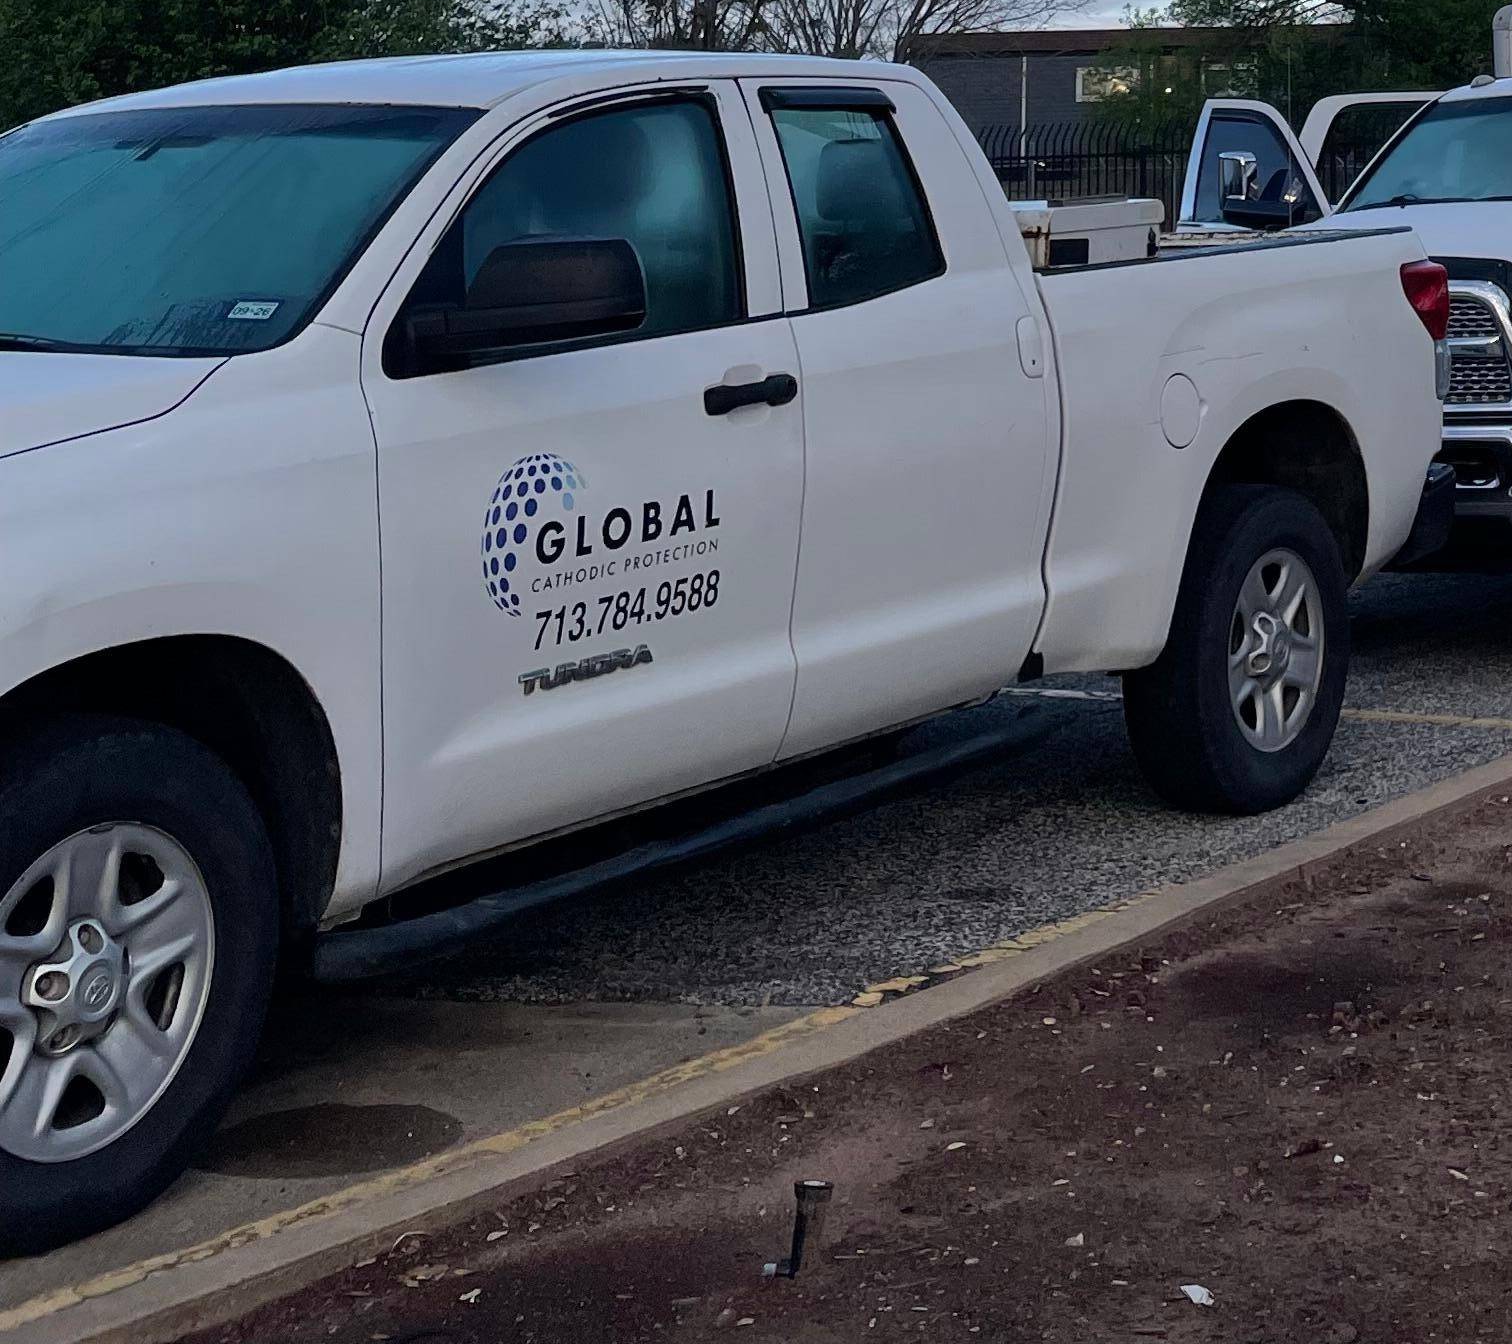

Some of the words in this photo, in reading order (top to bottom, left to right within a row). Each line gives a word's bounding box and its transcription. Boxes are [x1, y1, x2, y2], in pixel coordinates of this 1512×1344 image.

[535, 489, 721, 565] GLOBAL
[531, 562, 616, 593] CATHODIC
[624, 538, 719, 572] PROTECTION
[534, 569, 721, 651] 713.784.9588
[518, 644, 654, 696] TUNDRA
